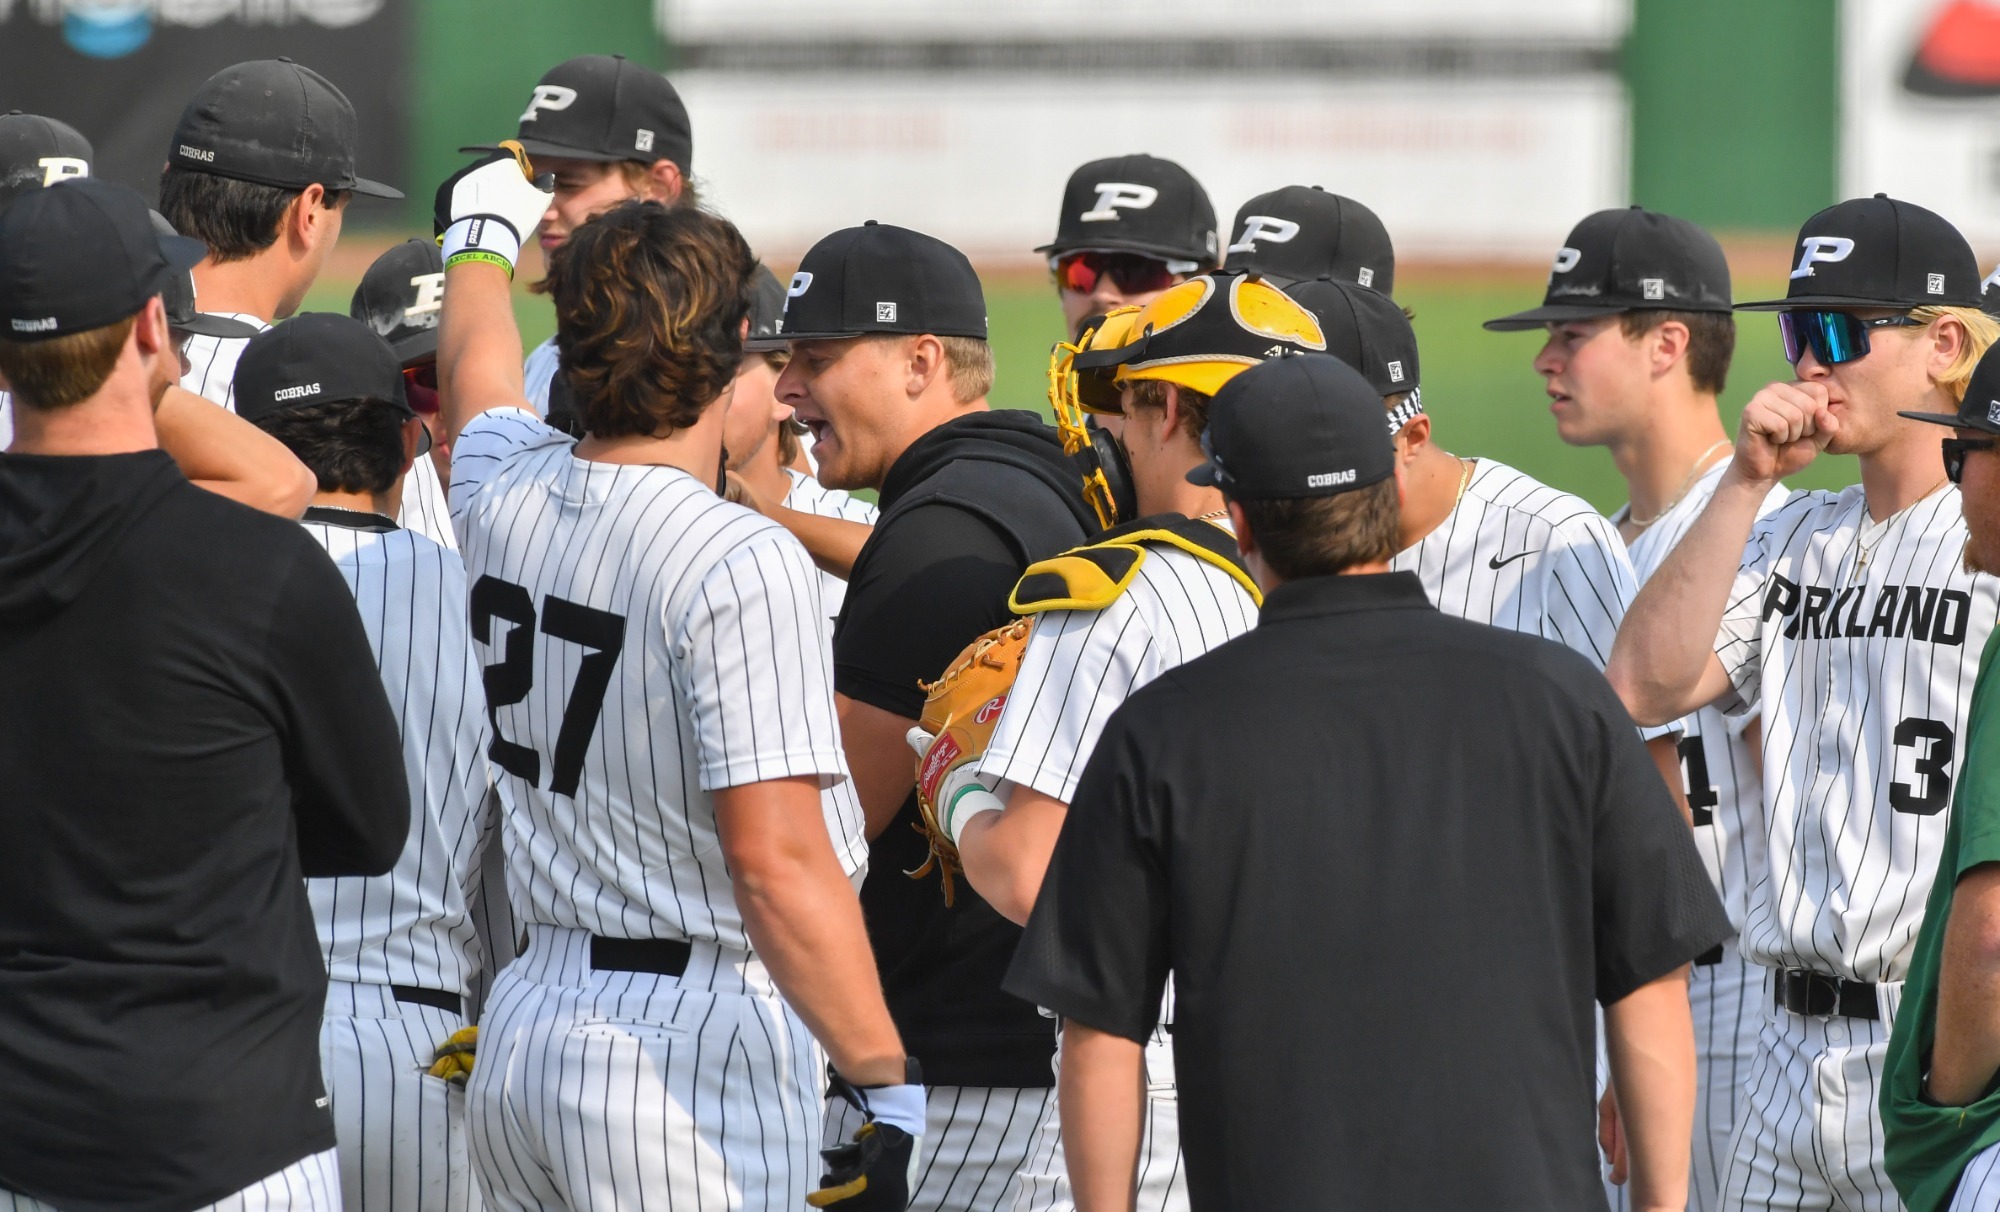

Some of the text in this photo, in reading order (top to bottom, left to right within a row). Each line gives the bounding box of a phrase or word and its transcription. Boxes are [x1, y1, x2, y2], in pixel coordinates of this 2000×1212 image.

[519, 84, 577, 122] P
[179, 144, 215, 162] COBRAS
[1080, 182, 1159, 222] P
[1228, 215, 1300, 253] P
[1790, 236, 1855, 279] P
[782, 271, 814, 313] P
[274, 382, 321, 401] COBRAS
[1307, 468, 1356, 488] COBRAS
[470, 573, 626, 798] 27
[1889, 716, 1954, 816] 3
